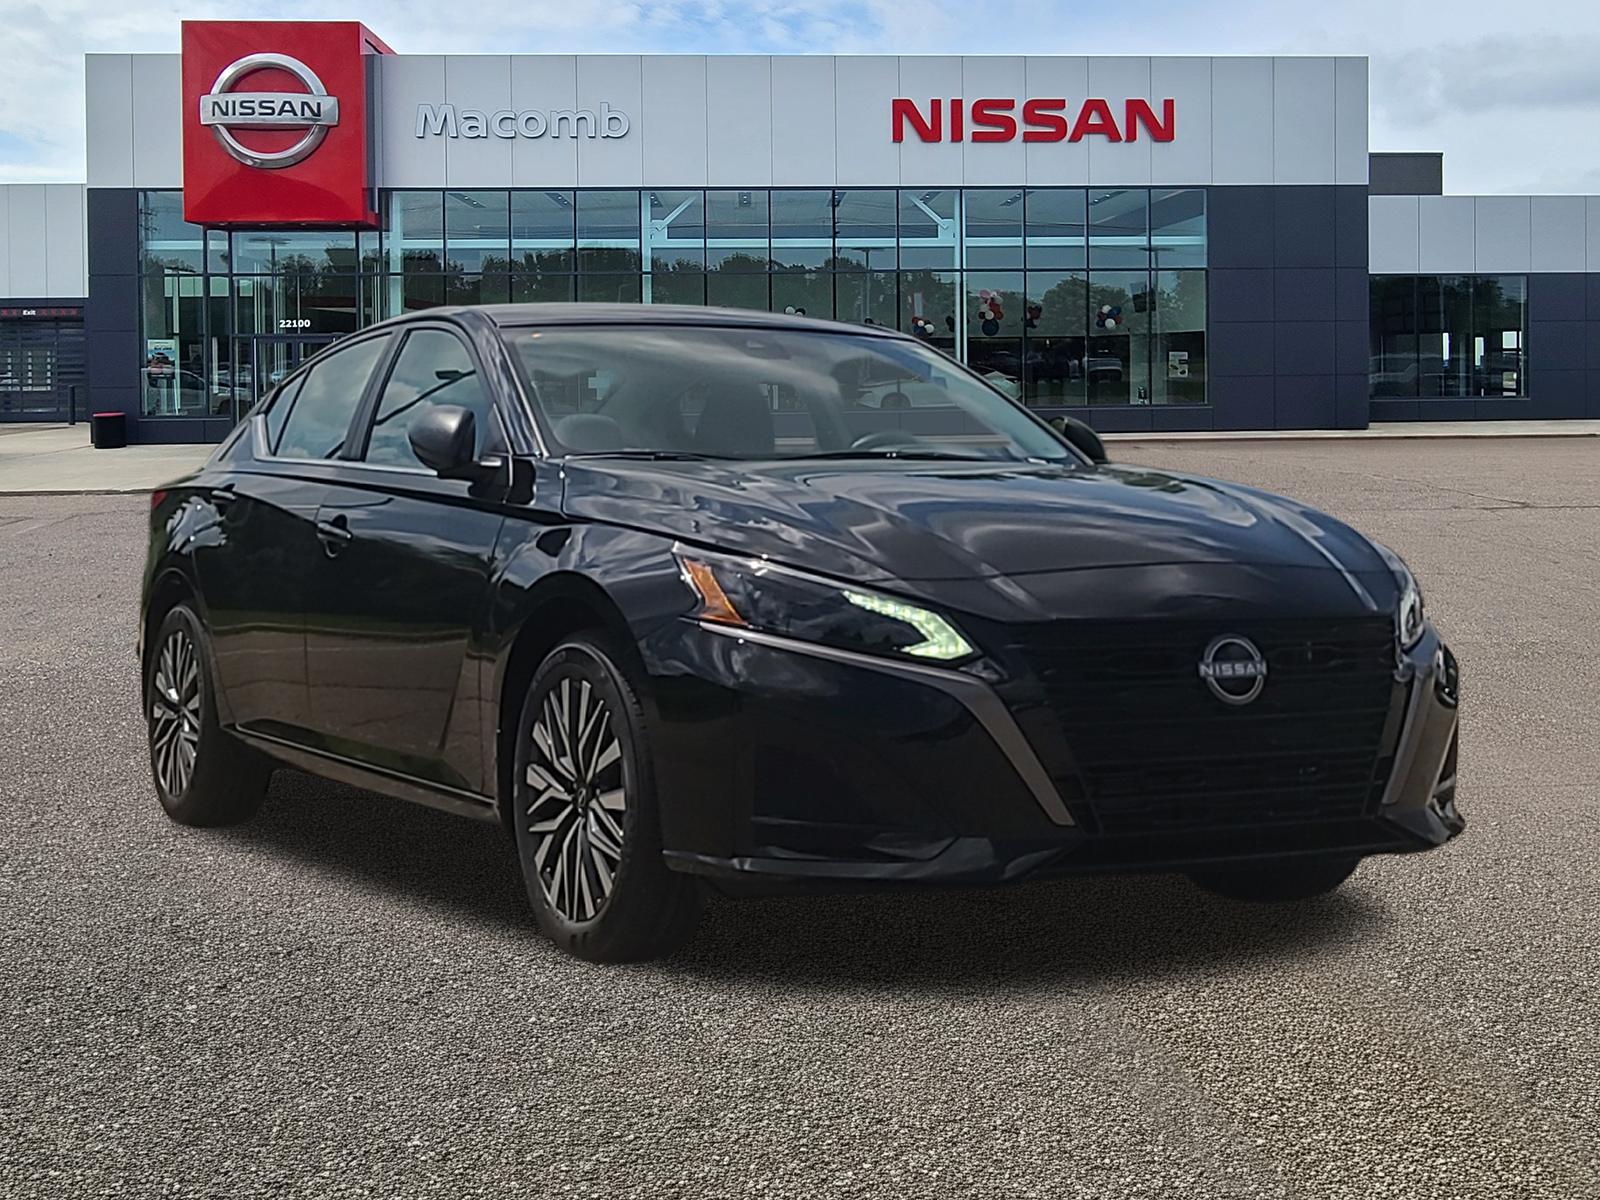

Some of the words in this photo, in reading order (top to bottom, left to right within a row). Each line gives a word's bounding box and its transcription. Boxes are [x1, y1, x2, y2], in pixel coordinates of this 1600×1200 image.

[212, 99, 322, 118] NISSAN
[415, 101, 630, 138] Macomb
[892, 98, 1175, 142] NISSAN
[279, 319, 311, 328] 22100
[1199, 662, 1267, 677] NISSAN
